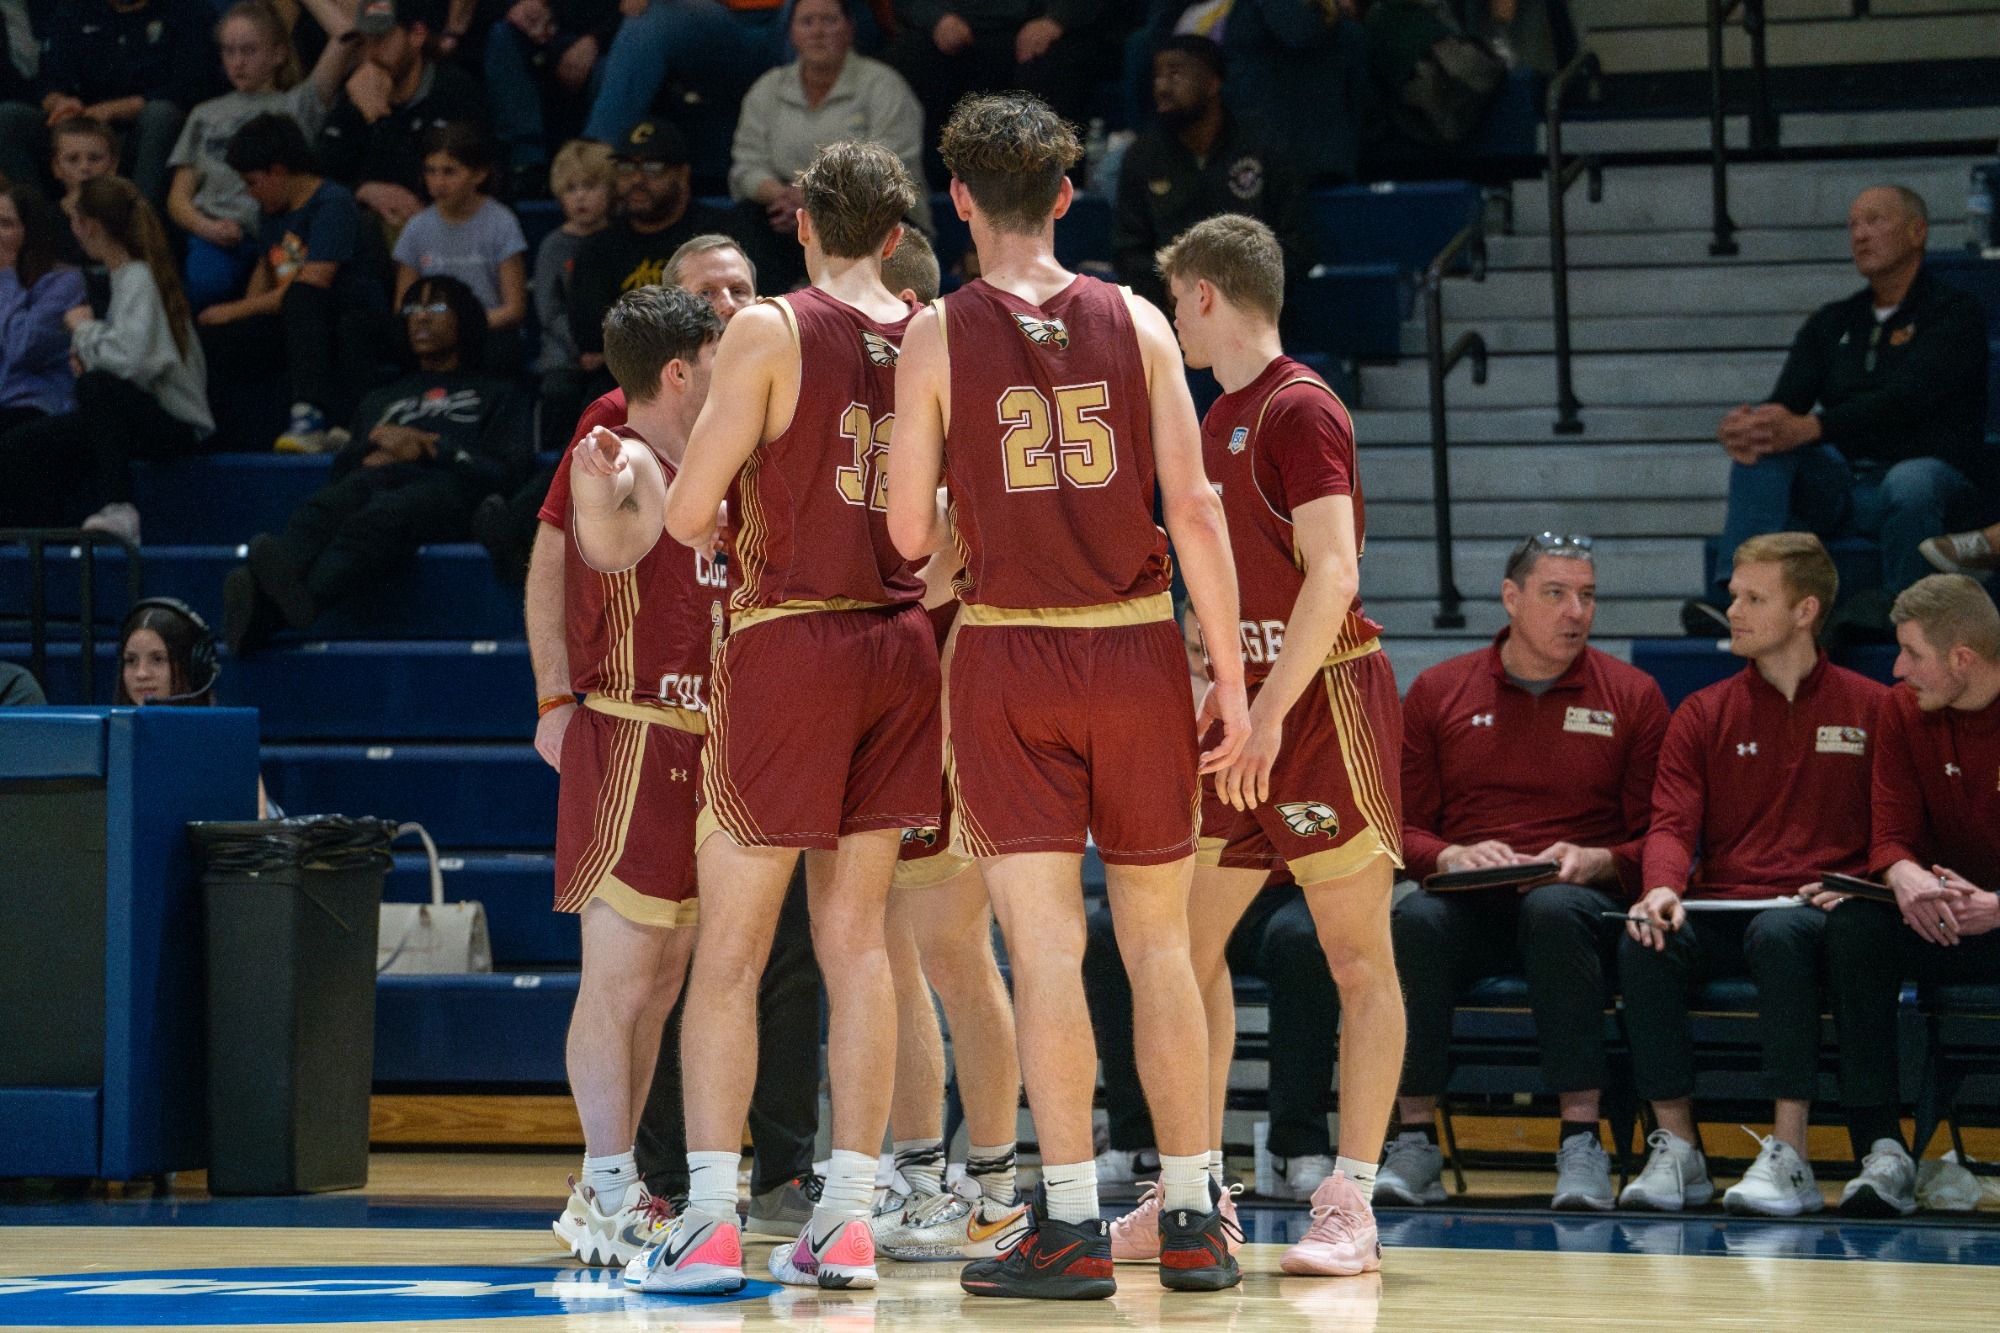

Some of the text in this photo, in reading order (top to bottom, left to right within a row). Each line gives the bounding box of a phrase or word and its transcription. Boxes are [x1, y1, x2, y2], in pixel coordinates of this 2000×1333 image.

[997, 381, 1118, 493] 25
[1240, 619, 1286, 663] GE
[658, 673, 713, 713] COL
